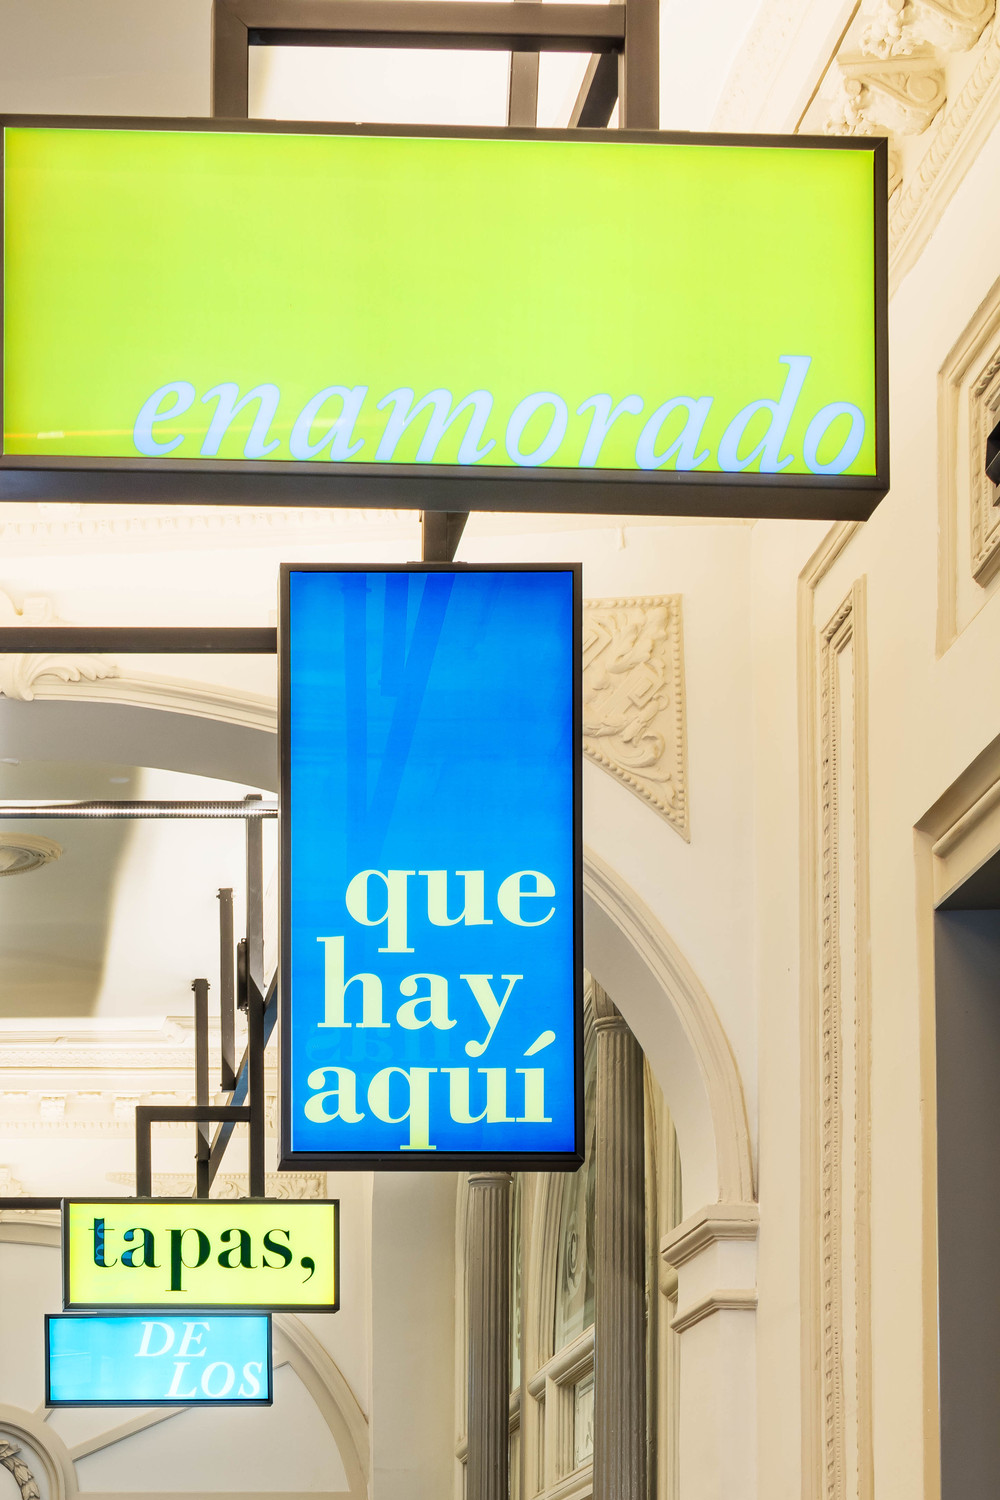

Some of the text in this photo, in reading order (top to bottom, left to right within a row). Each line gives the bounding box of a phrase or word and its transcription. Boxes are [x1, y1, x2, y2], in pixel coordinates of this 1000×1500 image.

[133, 355, 866, 475] enamorado
[345, 869, 556, 954] que
[316, 935, 524, 1058] hay
[304, 1029, 557, 1150] aquí
[88, 1217, 316, 1292] tapas,
[134, 1321, 211, 1358] DE
[164, 1361, 263, 1399] LOS
